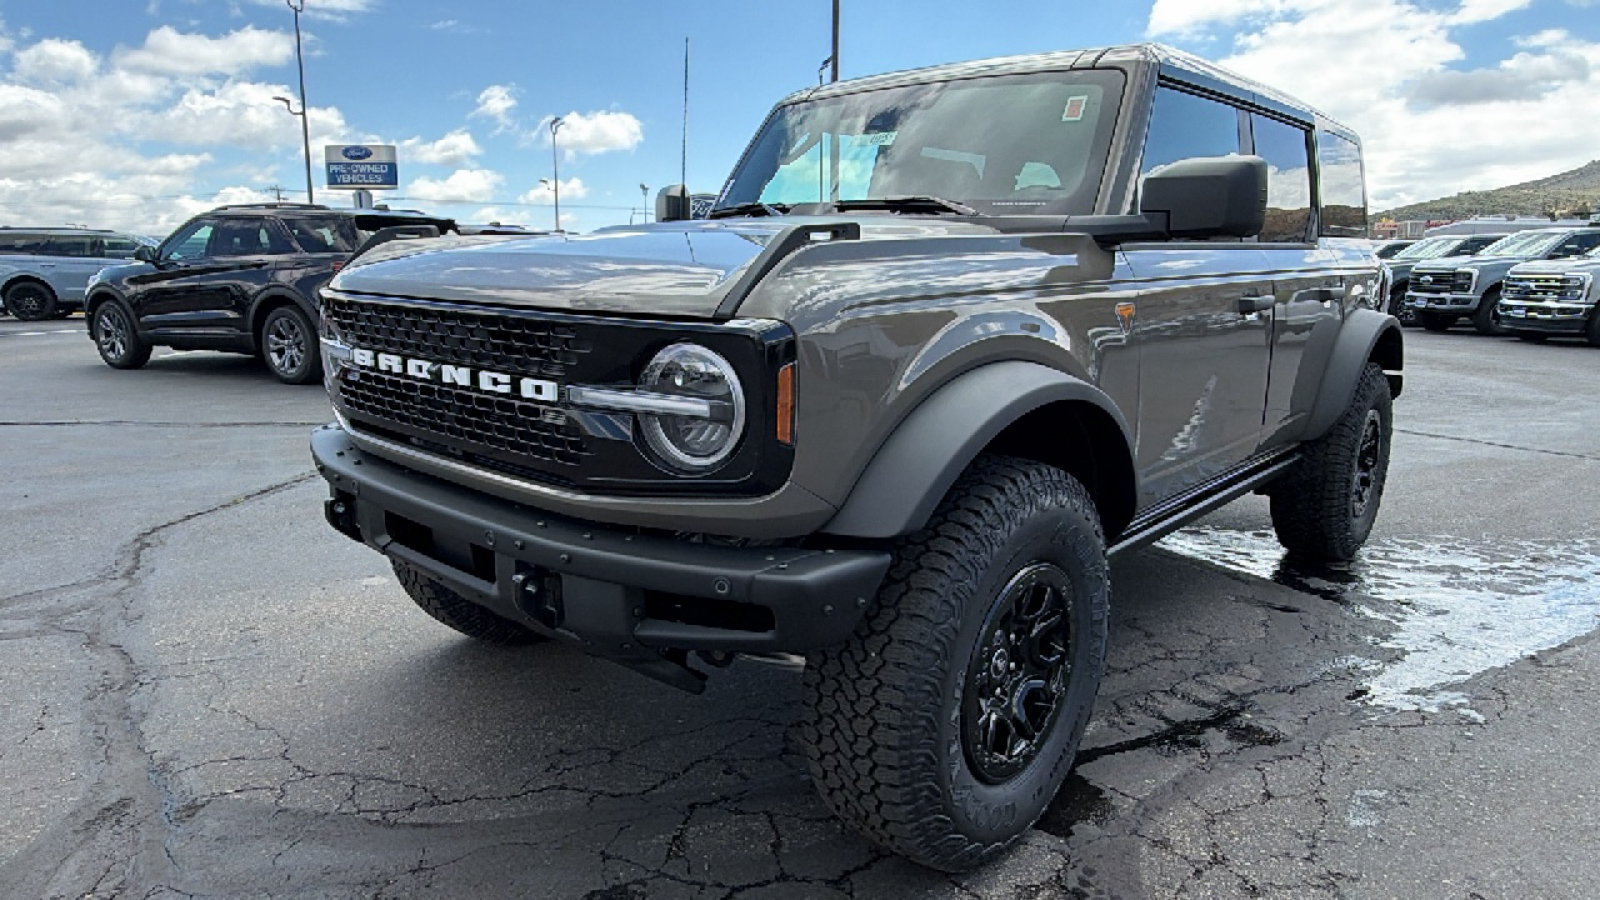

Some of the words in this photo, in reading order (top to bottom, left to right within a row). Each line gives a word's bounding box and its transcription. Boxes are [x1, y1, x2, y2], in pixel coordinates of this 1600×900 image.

[329, 164, 389, 173] PRE-OWNED
[335, 174, 382, 183] VEHICLES
[353, 348, 559, 402] BRONCO
